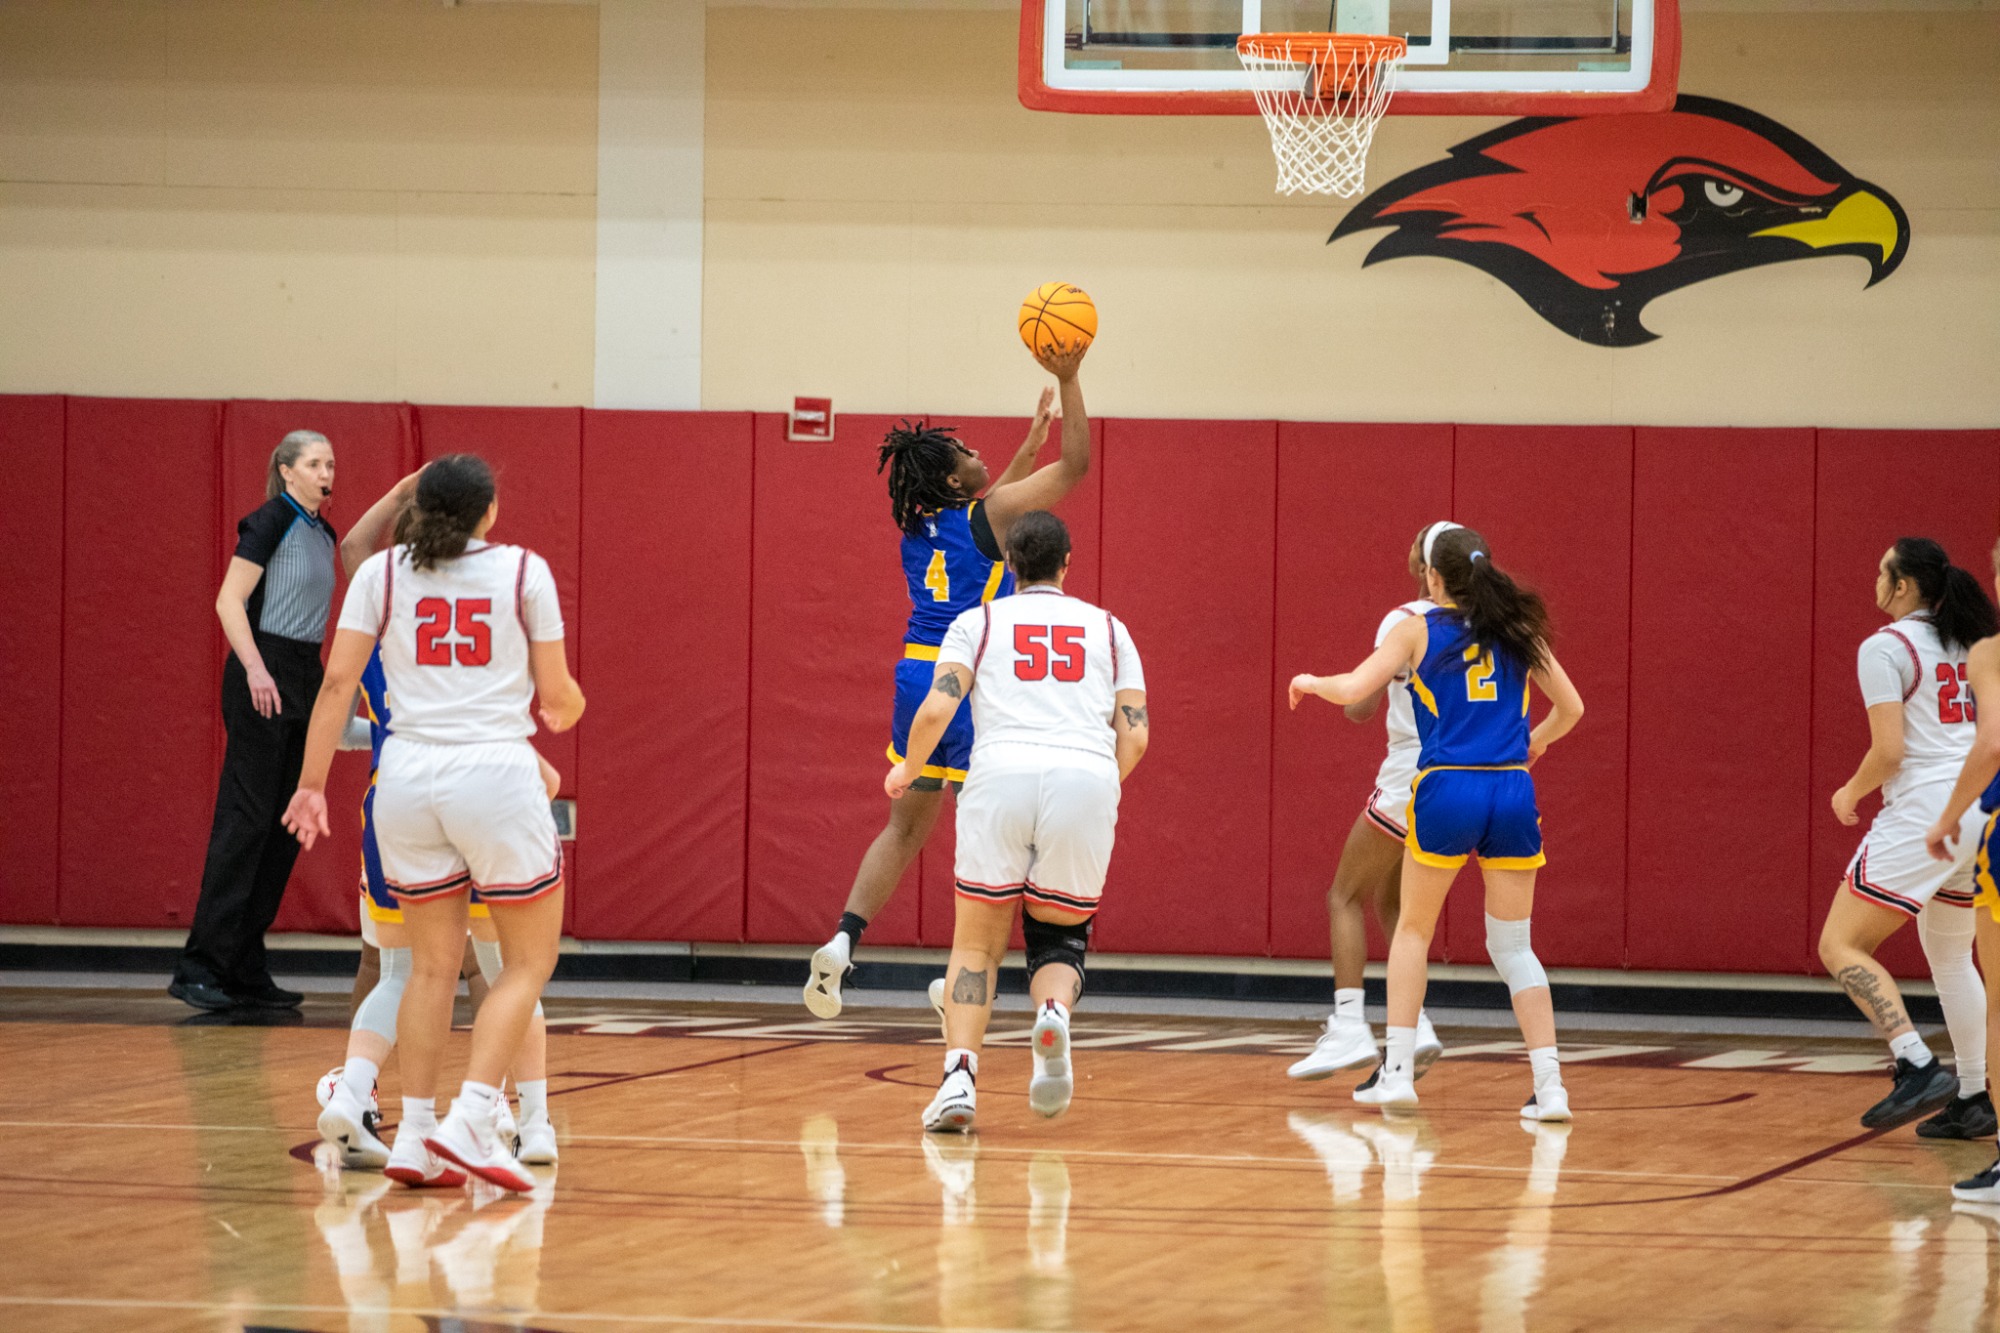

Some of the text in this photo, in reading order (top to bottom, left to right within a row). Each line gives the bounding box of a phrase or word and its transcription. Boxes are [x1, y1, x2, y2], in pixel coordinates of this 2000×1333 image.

[924, 549, 950, 602] 4
[415, 596, 492, 667] 25
[1013, 623, 1086, 683] 55
[1463, 643, 1498, 702] 2
